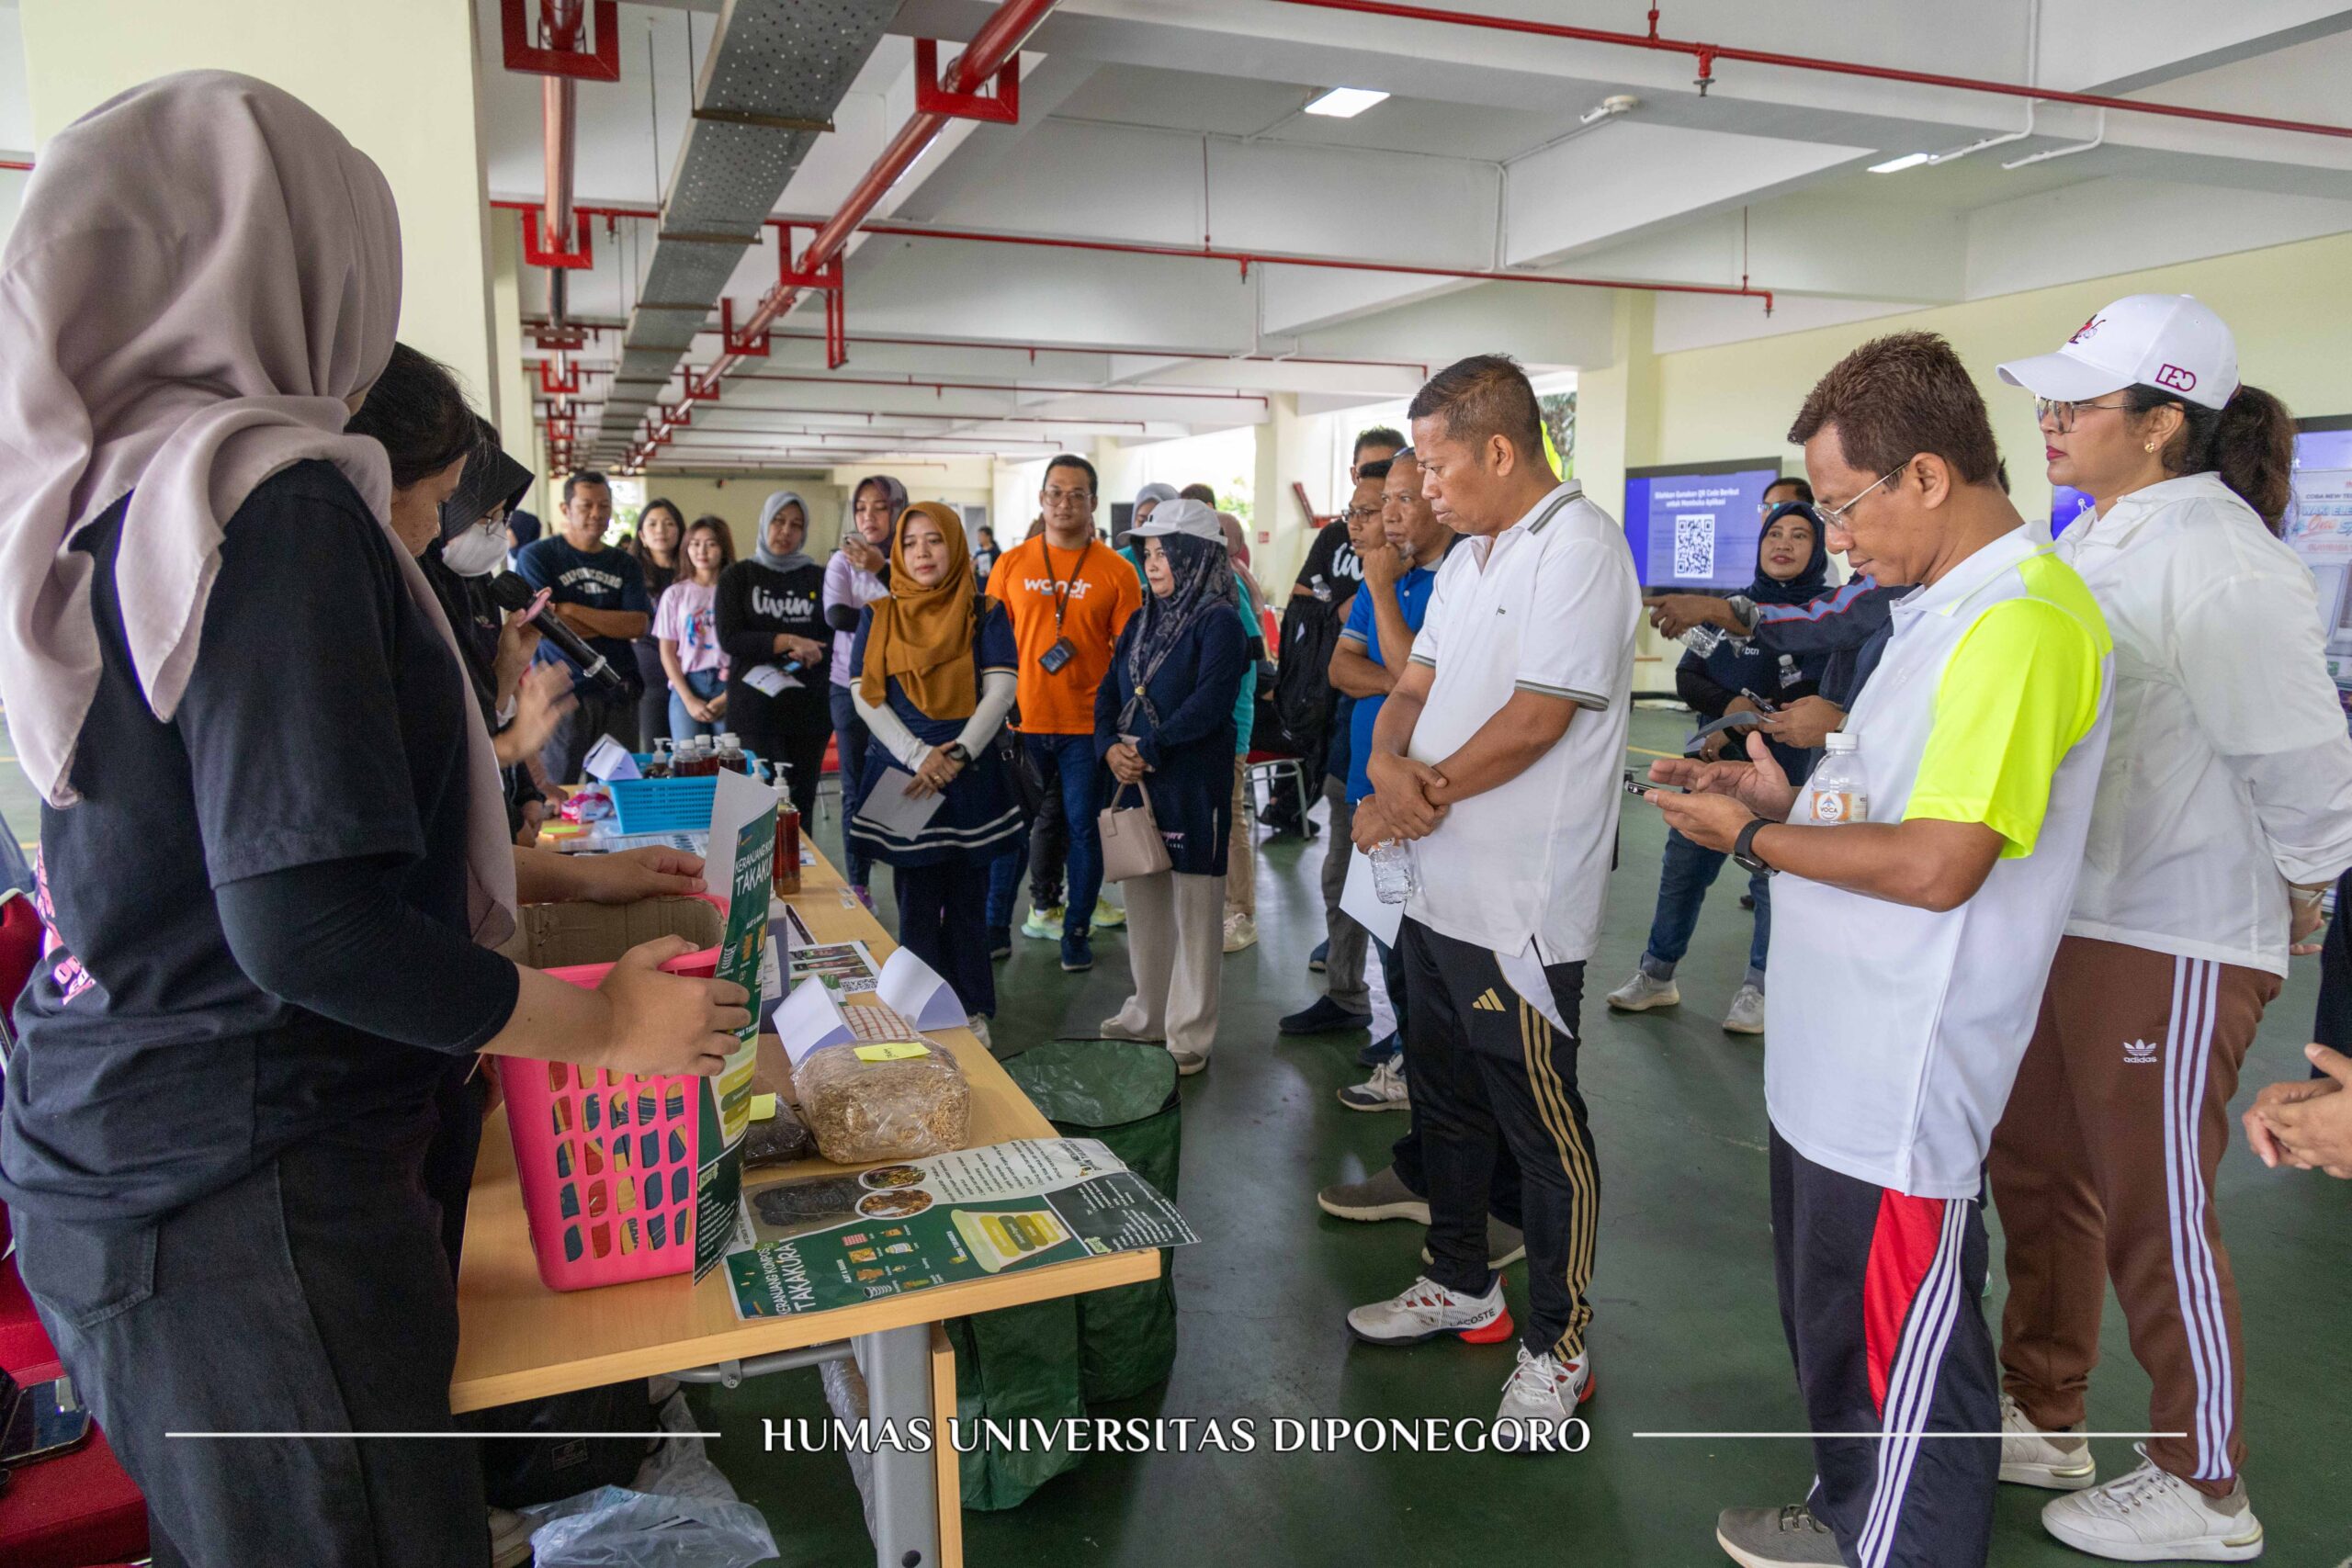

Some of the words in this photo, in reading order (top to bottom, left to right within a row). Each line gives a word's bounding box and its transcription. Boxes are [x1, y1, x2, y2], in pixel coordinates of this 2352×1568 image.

[736, 852, 774, 897] TAKAKU
[757, 1247, 778, 1275] KOMPOS
[774, 1242, 817, 1312] TAKAKURA
[765, 1274, 791, 1315] KERANJANG
